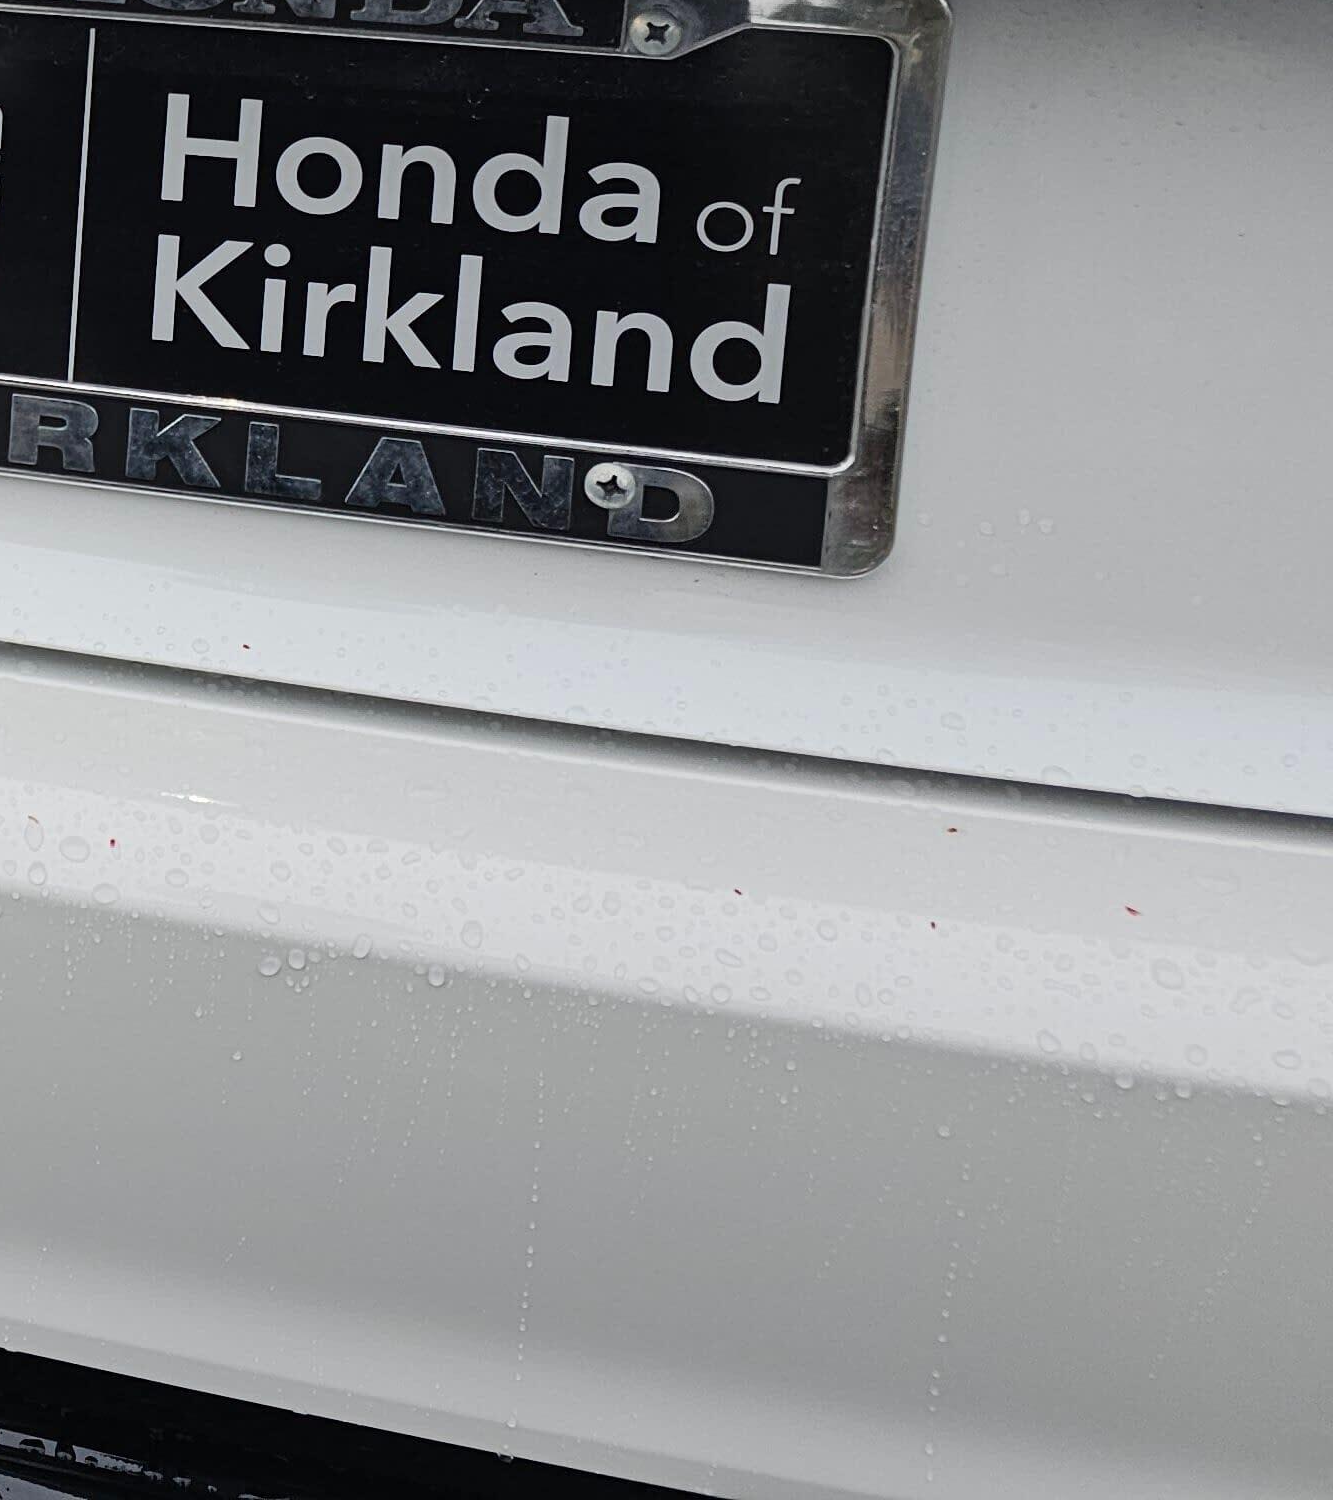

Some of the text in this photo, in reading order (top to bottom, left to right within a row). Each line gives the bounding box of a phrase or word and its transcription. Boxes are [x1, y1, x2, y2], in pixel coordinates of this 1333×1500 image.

[161, 93, 801, 256] Honda of
[151, 234, 792, 405] Kirkland
